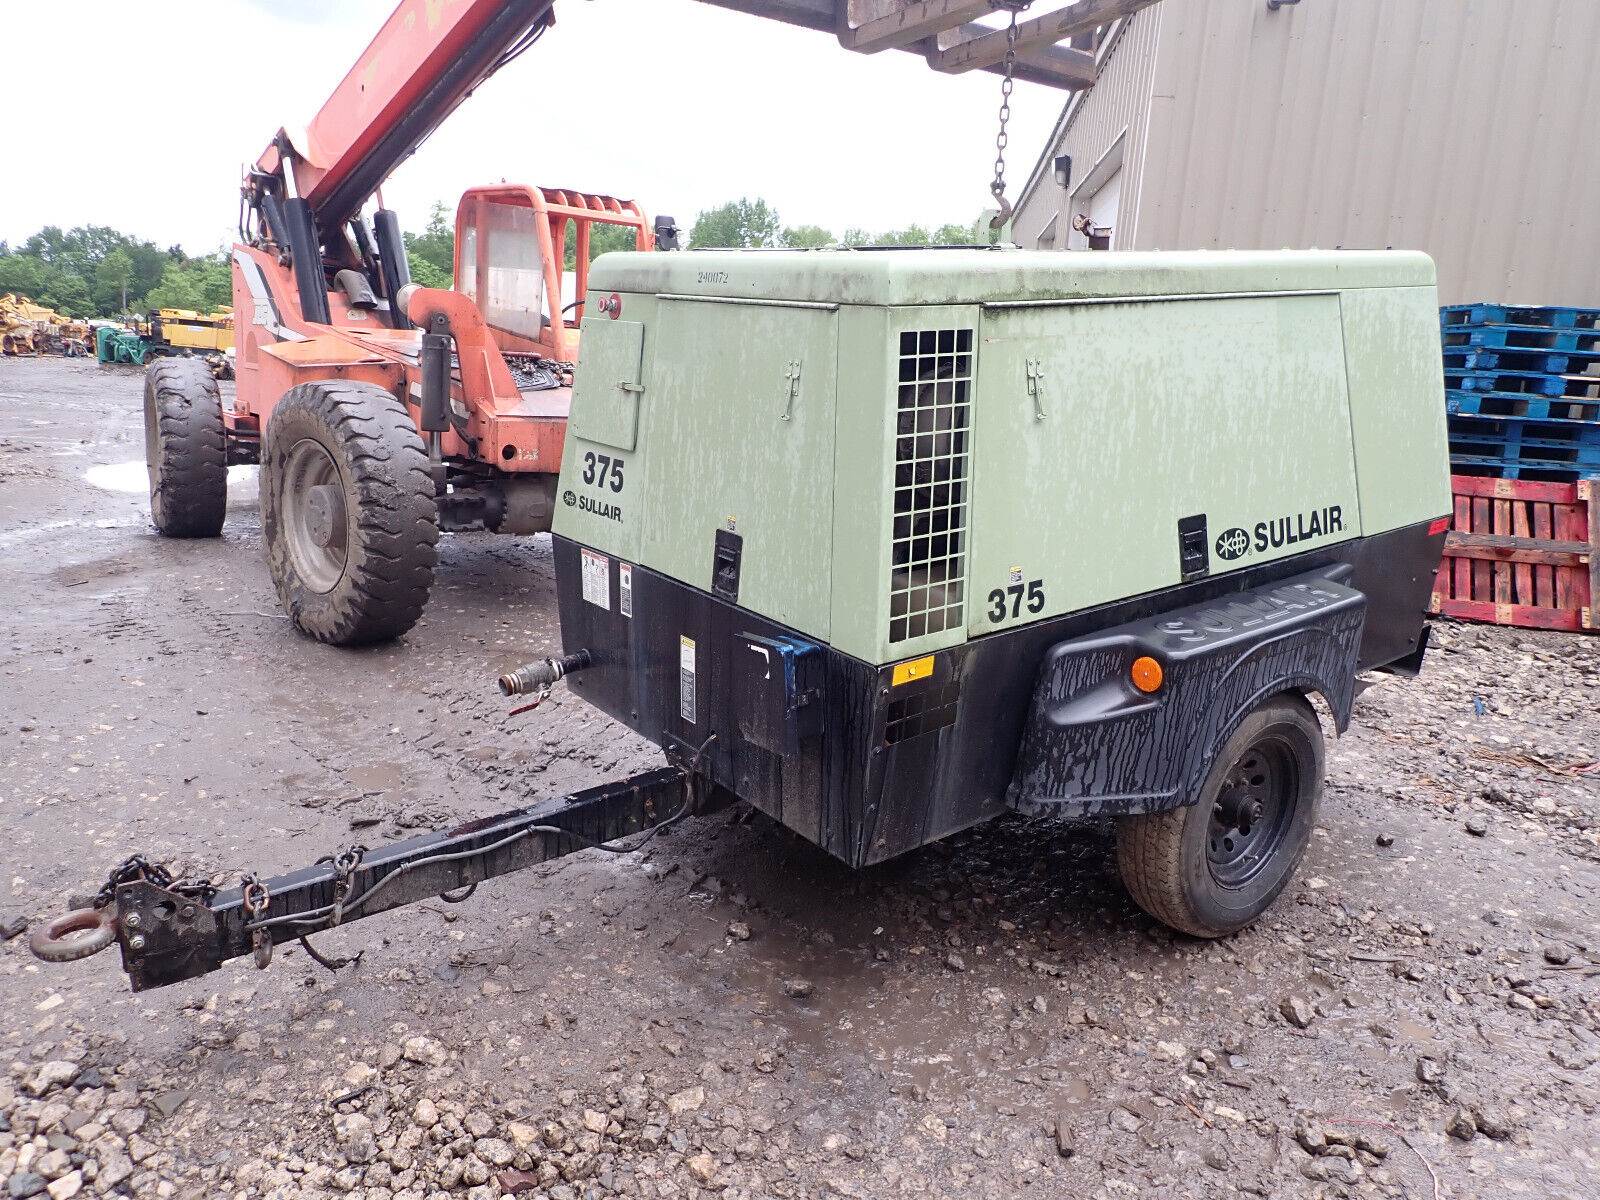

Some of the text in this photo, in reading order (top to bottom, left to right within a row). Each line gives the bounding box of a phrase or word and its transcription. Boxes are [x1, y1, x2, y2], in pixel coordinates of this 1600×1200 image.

[583, 452, 624, 493] 375
[579, 495, 622, 522] SULLAIR
[1254, 505, 1343, 553] SULLAIR
[988, 579, 1045, 623] 375
